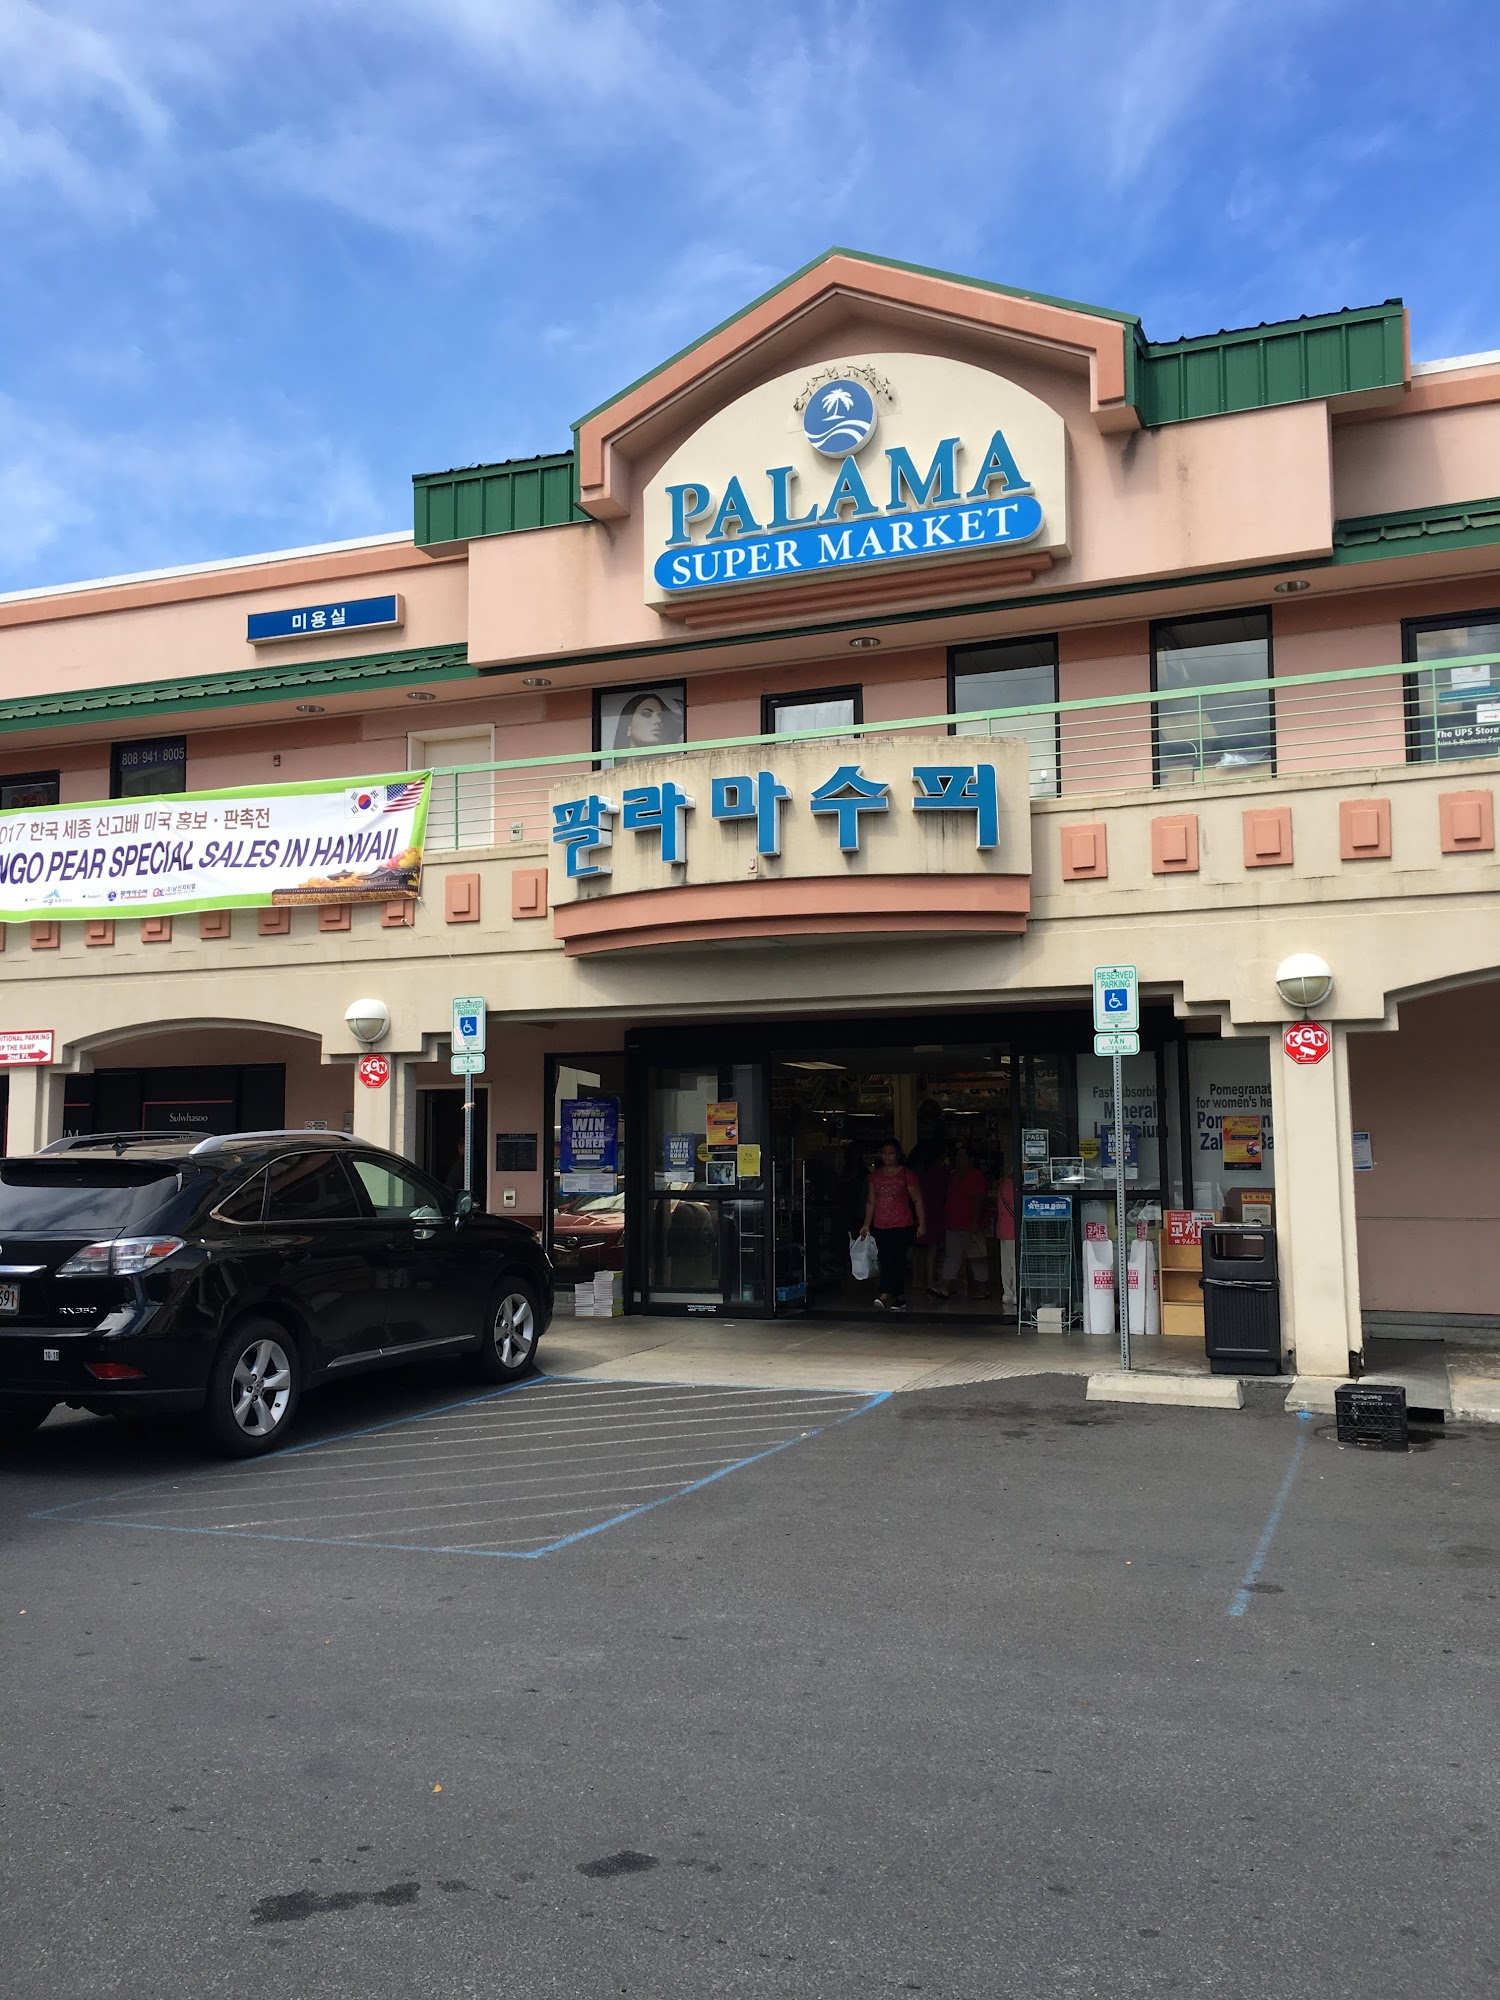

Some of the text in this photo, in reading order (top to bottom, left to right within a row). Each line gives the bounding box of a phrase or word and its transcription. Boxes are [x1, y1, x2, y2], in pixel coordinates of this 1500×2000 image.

[665, 430, 1035, 548] PALAMA
[672, 503, 1019, 585] SUPER MARKET
[292, 607, 346, 630] 미용실
[1437, 726, 1500, 738] The UPS Store
[30, 821, 58, 841] 한국
[62, 818, 92, 839] 세종
[96, 813, 139, 837] 신고배
[144, 811, 172, 831] 미국
[176, 810, 208, 830] 홍보
[224, 807, 270, 830] 판촉전
[552, 764, 1000, 880] 팔라마수퍼
[45, 848, 106, 881] PEAR
[109, 841, 193, 878] SPECIAL
[199, 839, 280, 868] SALES
[280, 838, 310, 867] IN
[309, 827, 399, 866] HAWAII
[1097, 971, 1134, 980] RESERVED
[1101, 980, 1130, 988] PARKING
[454, 1001, 482, 1009] RESERVED
[458, 1009, 480, 1017] PARKING
[1290, 1030, 1324, 1045] KCN
[363, 1060, 385, 1073] KCN
[1093, 1087, 1114, 1098] Fast
[1196, 1097, 1210, 1108] for
[1213, 1096, 1257, 1108] women's
[1104, 1101, 1157, 1119] Mneral
[169, 1112, 208, 1123] Sulwhasoo
[572, 1118, 605, 1131] WIN
[572, 1131, 605, 1139] A TRIP TO
[1107, 1134, 1131, 1142] WN
[571, 1139, 605, 1149] KOREA
